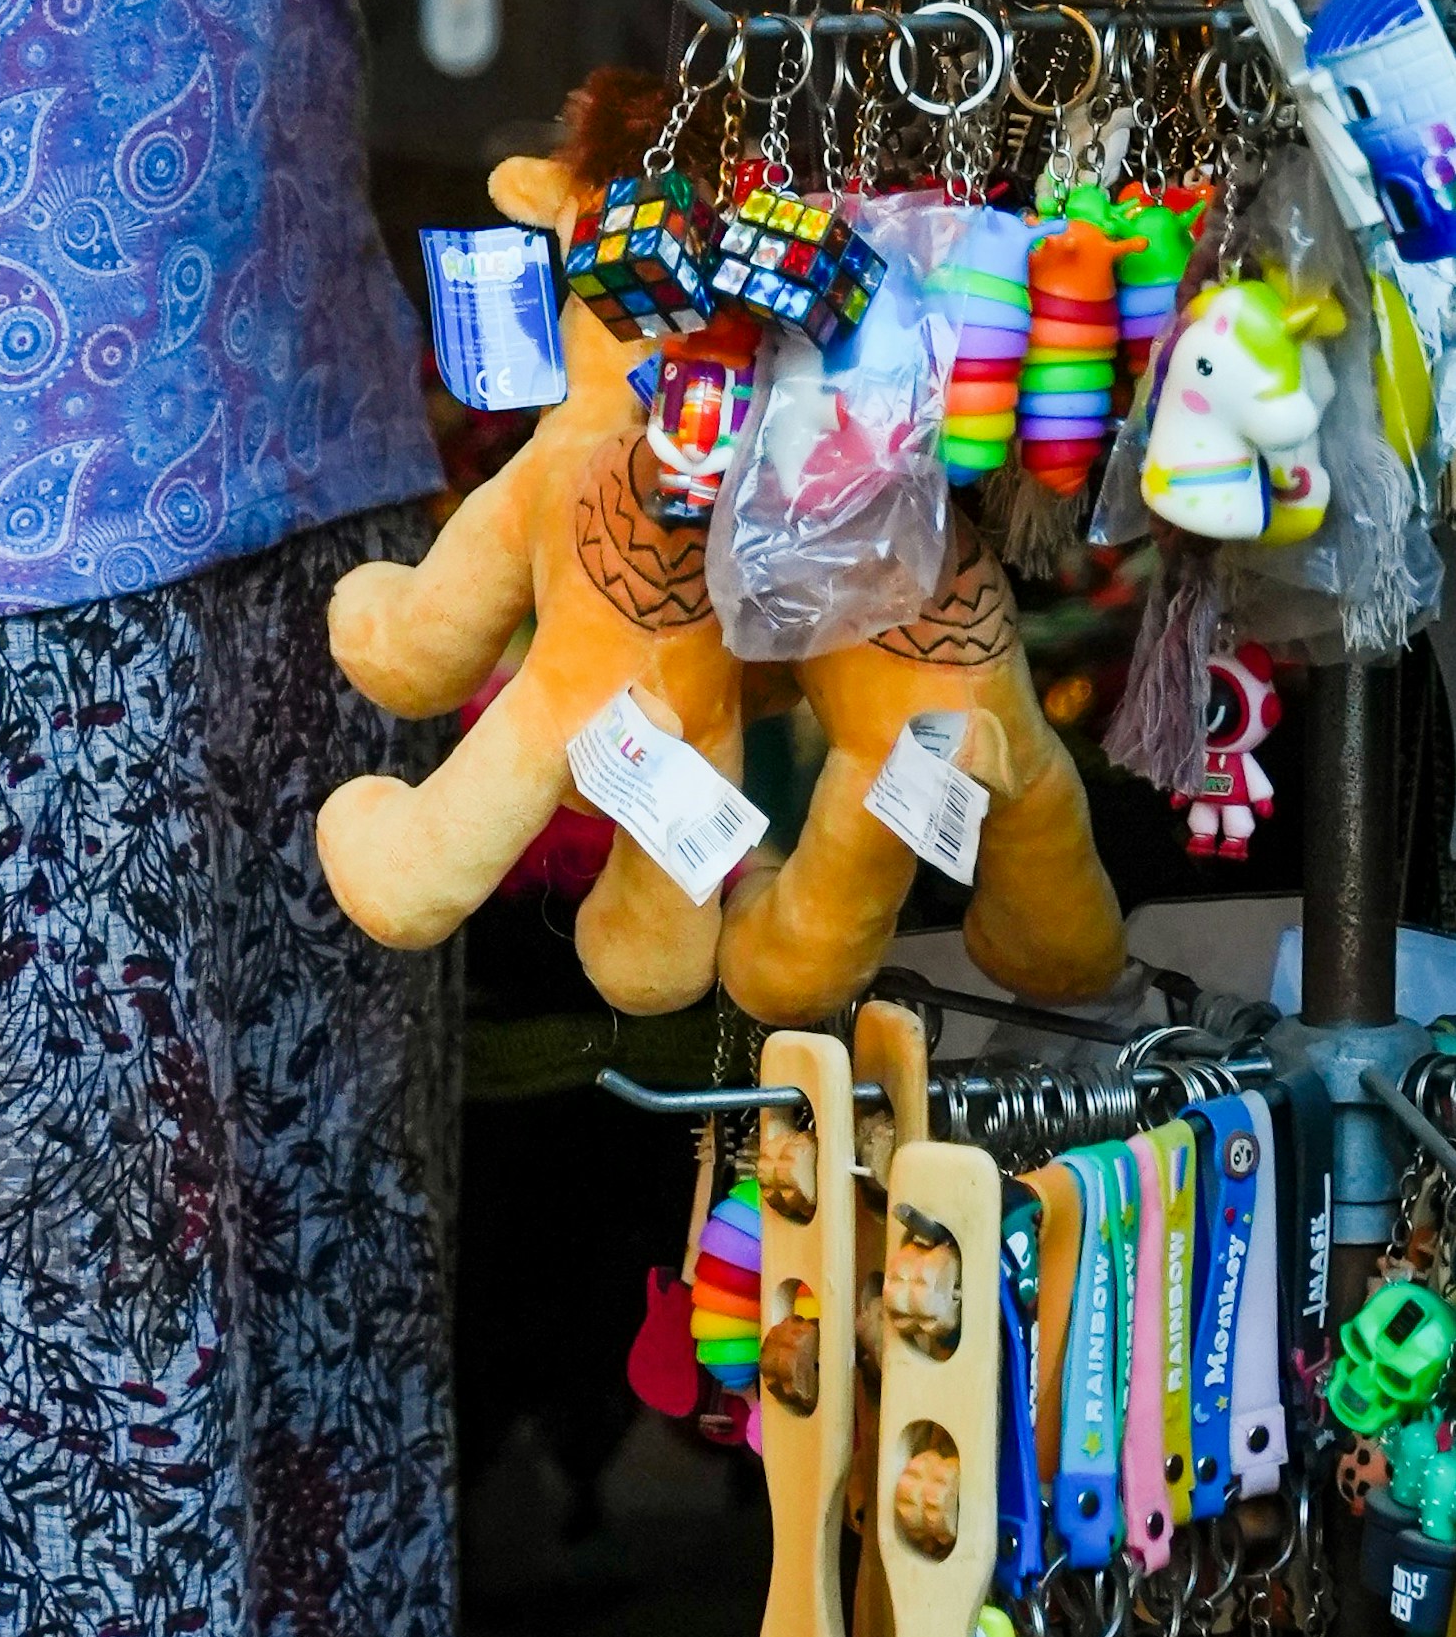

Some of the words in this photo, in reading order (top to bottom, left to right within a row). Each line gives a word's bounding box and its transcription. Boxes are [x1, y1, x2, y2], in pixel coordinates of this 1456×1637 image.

[1085, 1253, 1111, 1423] RAINBOW
[1167, 1231, 1185, 1393] RAINBOW
[1203, 1233, 1247, 1388] Monkey
